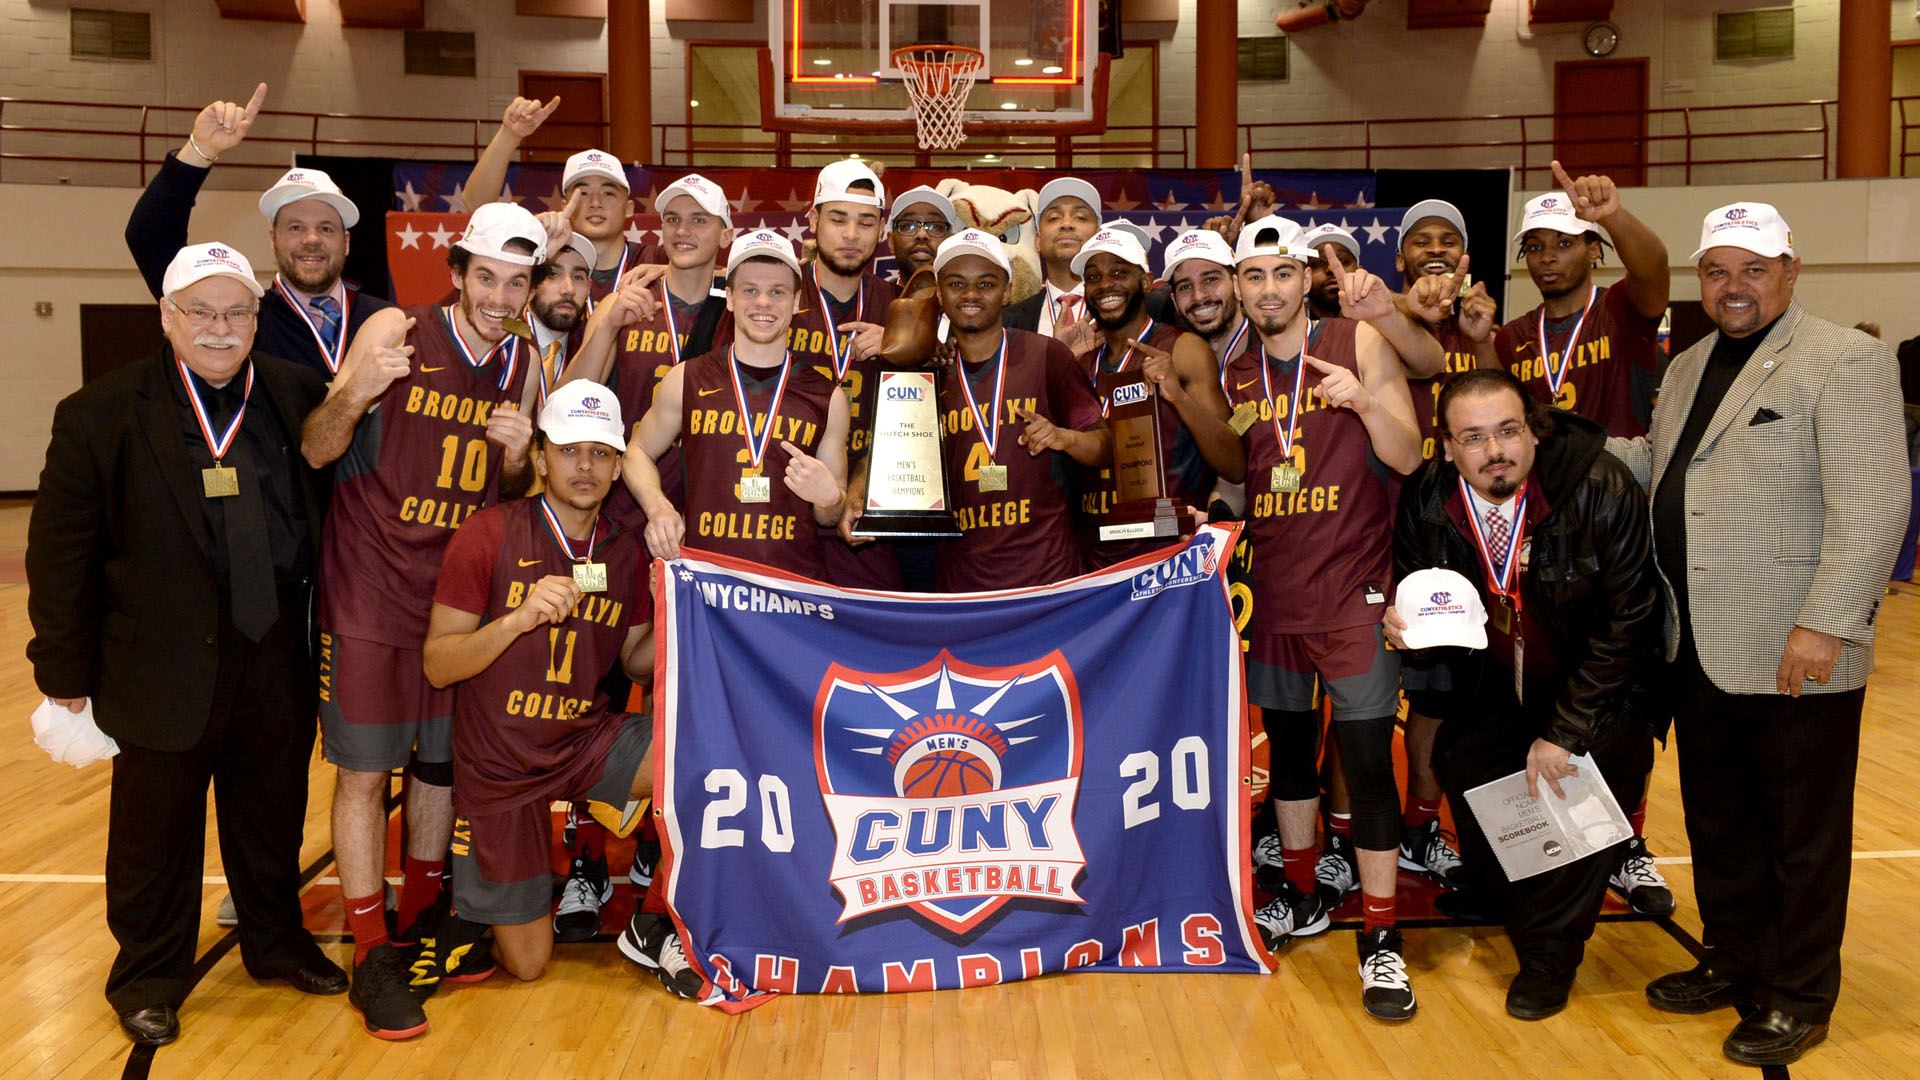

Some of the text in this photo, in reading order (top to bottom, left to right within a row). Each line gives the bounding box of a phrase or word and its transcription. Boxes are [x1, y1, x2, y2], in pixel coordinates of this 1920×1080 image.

[436, 434, 488, 492] 10
[896, 461, 917, 470] MEN'S
[963, 441, 990, 482] 4
[888, 488, 926, 497] HAMPIONS
[699, 511, 797, 540] COLLEGE
[1133, 543, 1216, 591] CUNY
[1368, 585, 1376, 593] L
[546, 628, 577, 684] 11
[926, 736, 970, 751] MEN'S
[701, 735, 1211, 853] 20 20
[847, 793, 1062, 866] CUNY
[1497, 819, 1550, 843] SCOREBOOK
[1501, 814, 1545, 832] BASKETBALL
[857, 864, 1064, 907] BASKETBALL
